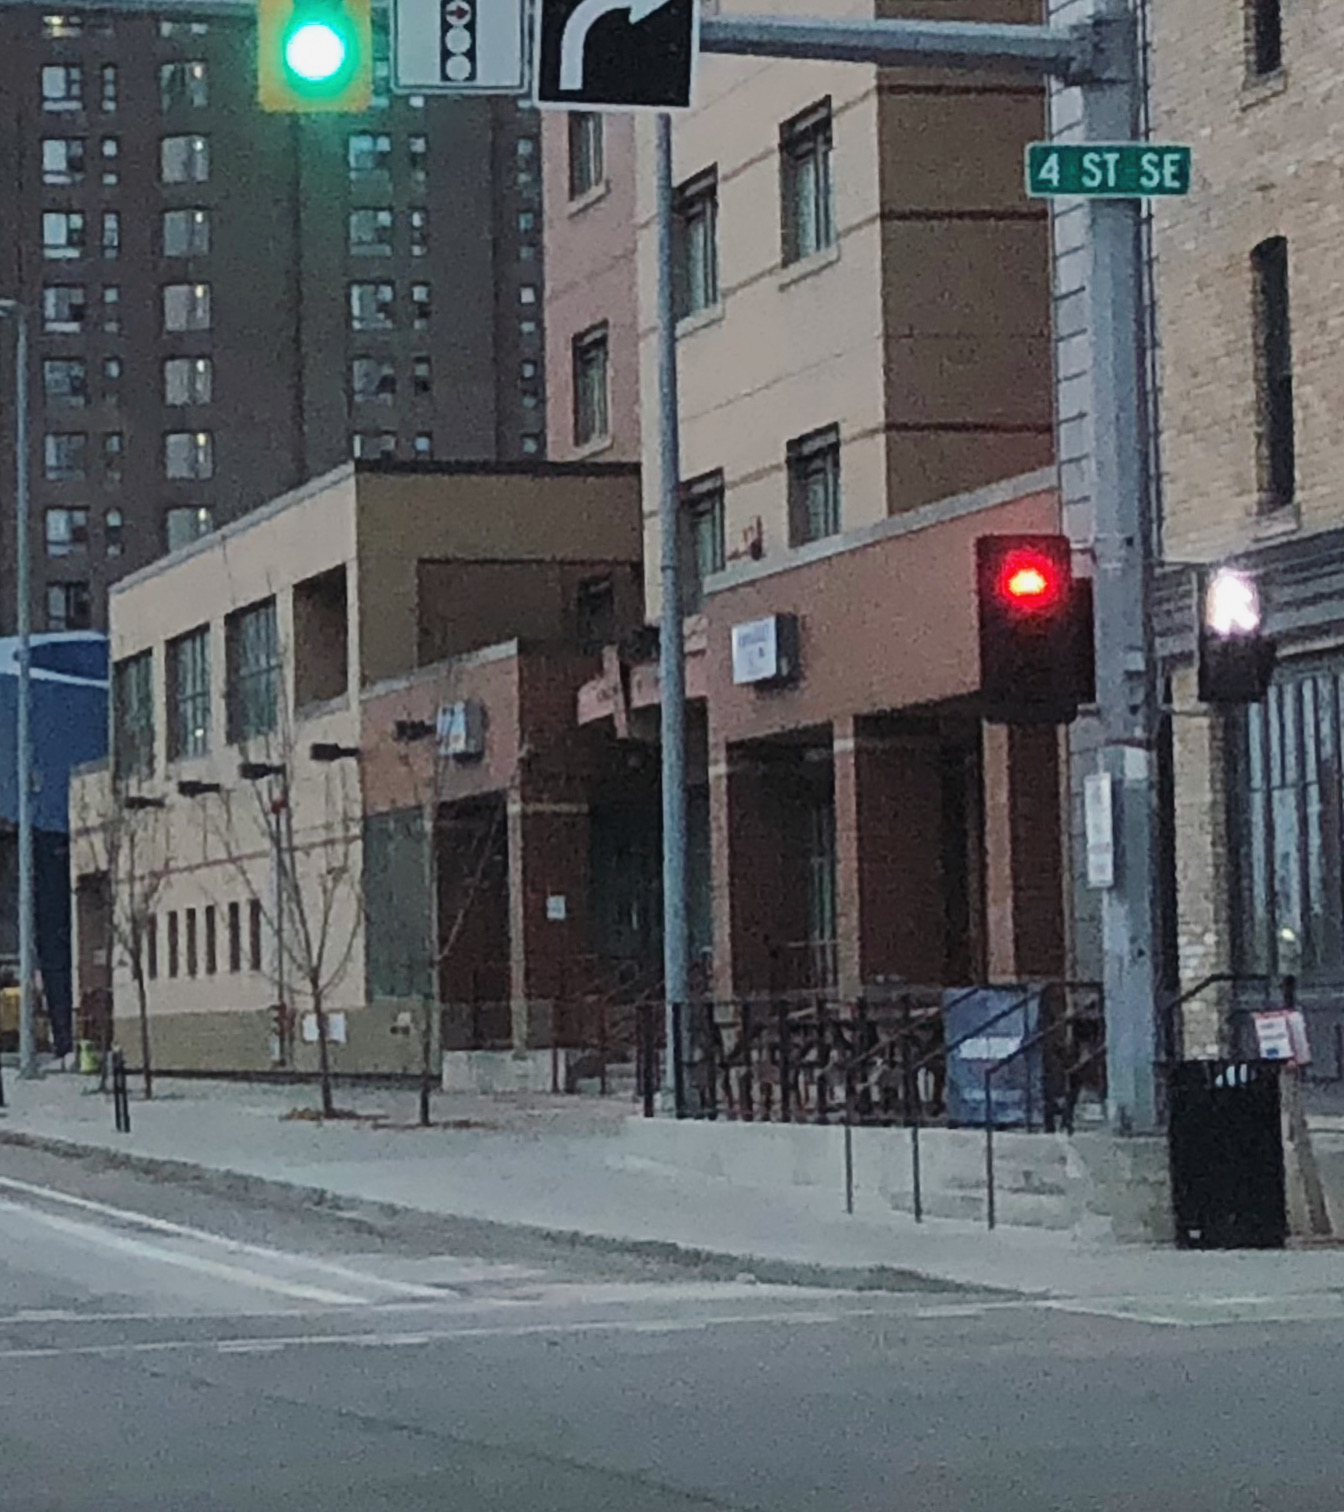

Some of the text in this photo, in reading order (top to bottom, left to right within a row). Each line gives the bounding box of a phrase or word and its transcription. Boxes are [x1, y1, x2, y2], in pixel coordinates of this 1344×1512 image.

[1037, 152, 1181, 188] 4 ST SE
